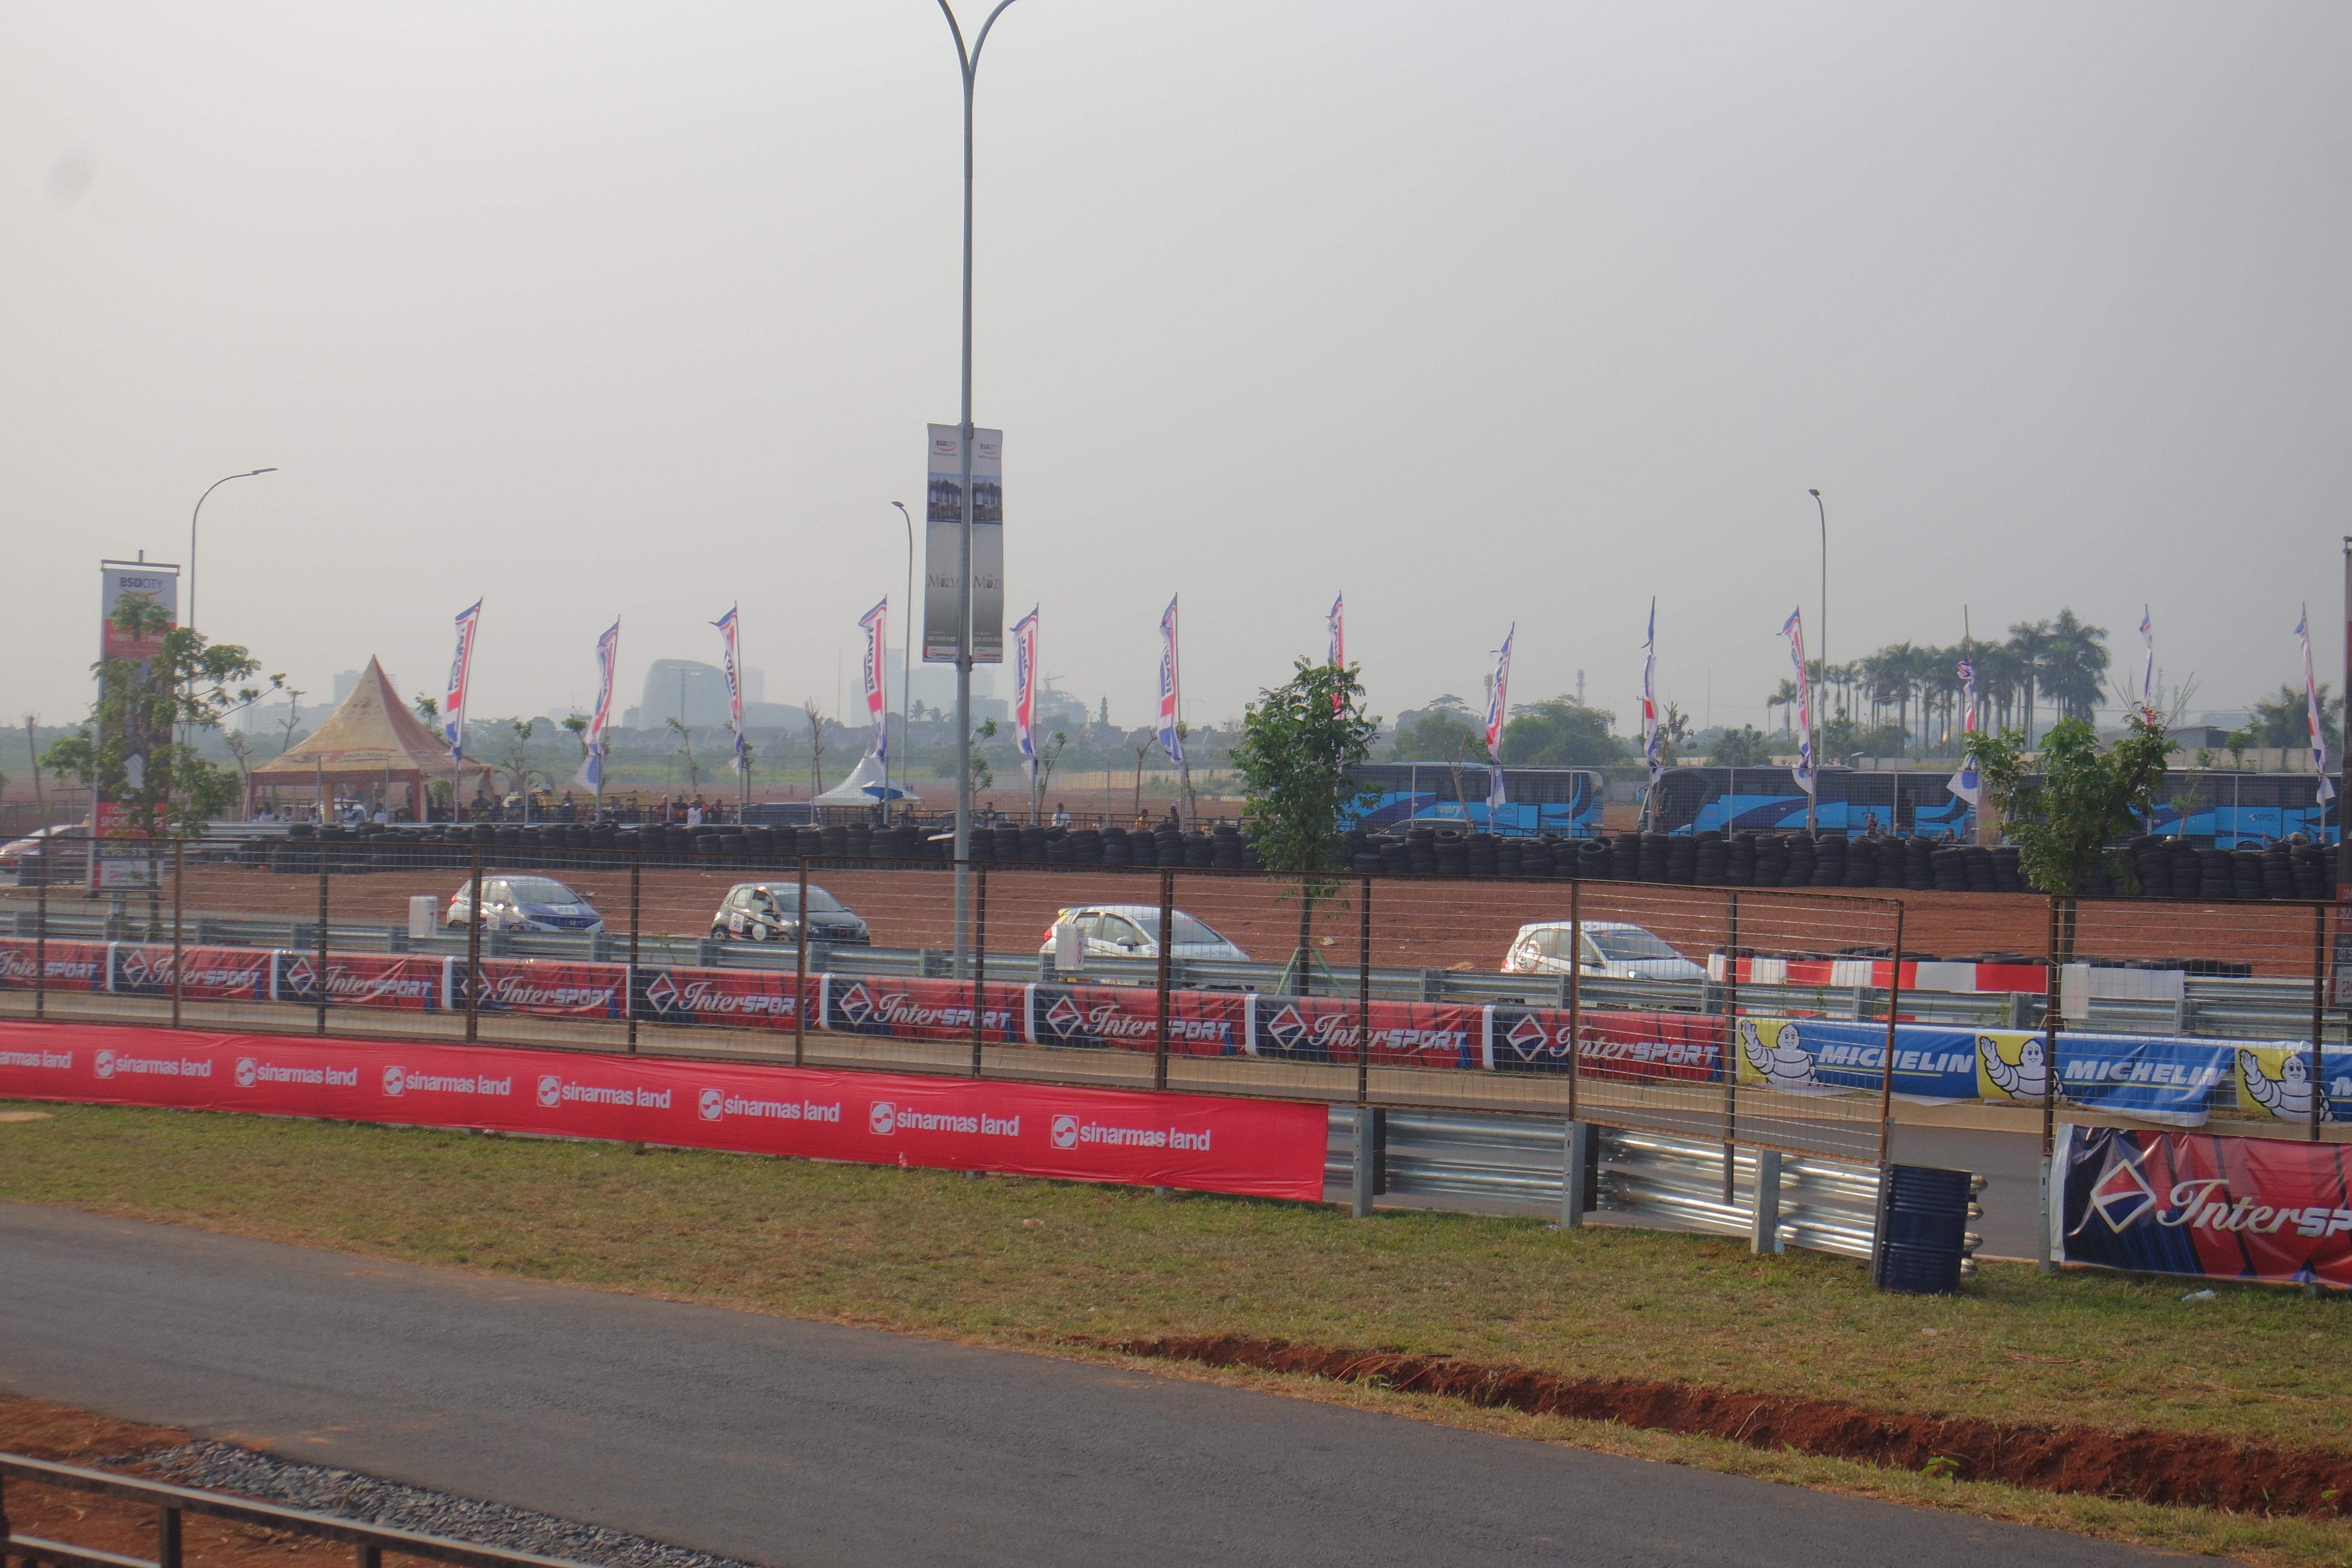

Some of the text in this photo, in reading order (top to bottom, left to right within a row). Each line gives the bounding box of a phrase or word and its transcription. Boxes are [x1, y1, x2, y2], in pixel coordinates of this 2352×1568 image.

[0, 950, 97, 978] InteSPORT
[678, 981, 808, 1015] InterSPOR
[1083, 1005, 1231, 1041] InterPORT
[44, 1050, 72, 1069] land
[116, 1054, 212, 1077] sinarmas land
[1818, 1045, 1975, 1073] MICHELIN
[2064, 1060, 2228, 1086] MICHELIN
[258, 1063, 358, 1086] sinarmas land
[405, 1071, 511, 1096] sinarmas land
[561, 1081, 671, 1109] sinarmas land
[724, 1094, 841, 1122] sinarmas land
[897, 1108, 1019, 1136] sinarmas land
[1079, 1121, 1211, 1151] sinarmas land
